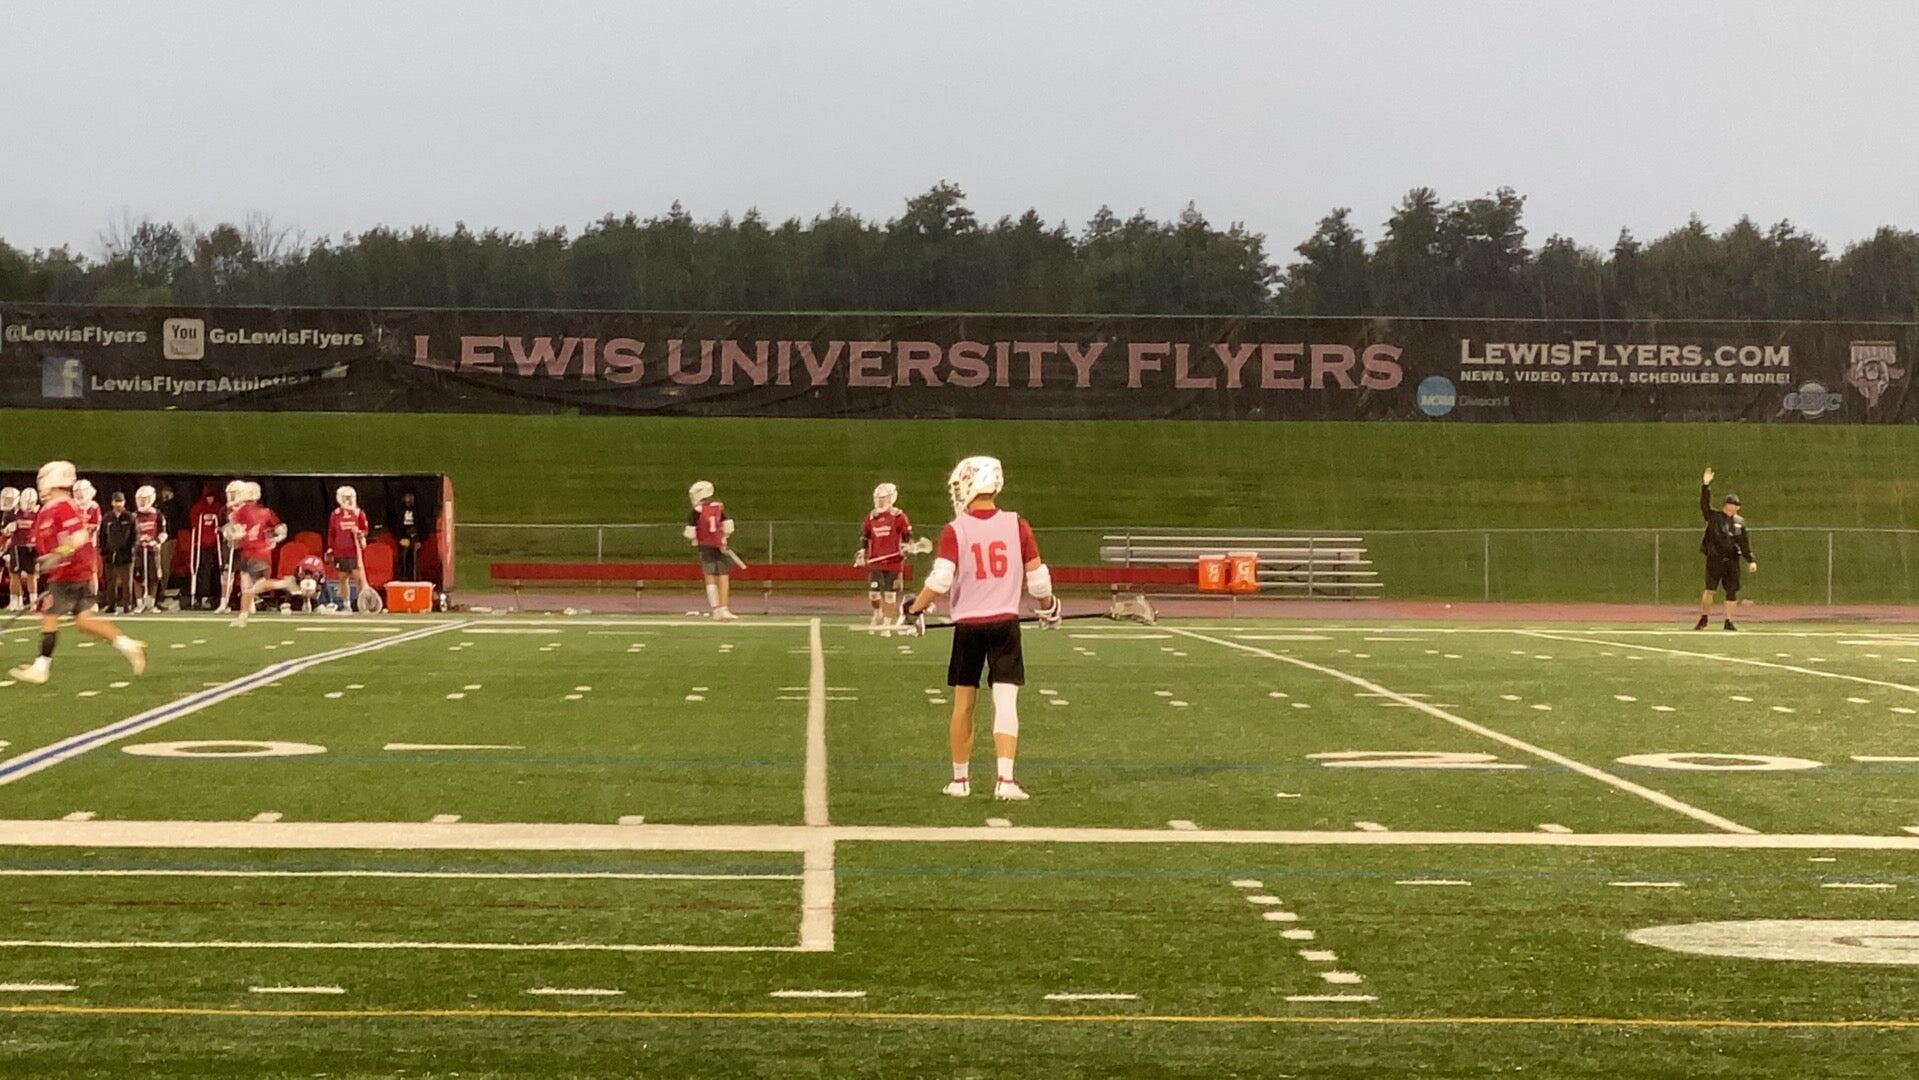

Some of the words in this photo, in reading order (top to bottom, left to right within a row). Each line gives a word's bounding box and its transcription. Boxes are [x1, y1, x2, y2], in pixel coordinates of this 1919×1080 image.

[5, 325, 147, 346] @LewisFlyers
[171, 324, 197, 340] You
[209, 328, 365, 347] GoLewisFlyers
[413, 335, 646, 384] LEWIS
[666, 339, 1108, 389] UNIVERSITY
[1126, 341, 1404, 391] FLYERS
[1460, 371, 1510, 384] NEWS,
[1515, 371, 1566, 385] VIDEO,
[1571, 372, 1624, 385] STATS,
[1629, 372, 1719, 385] SCHEDULES
[1724, 373, 1736, 385] &
[1741, 373, 1791, 385] MORE!
[709, 515, 717, 533] 1
[971, 541, 1008, 580] 16
